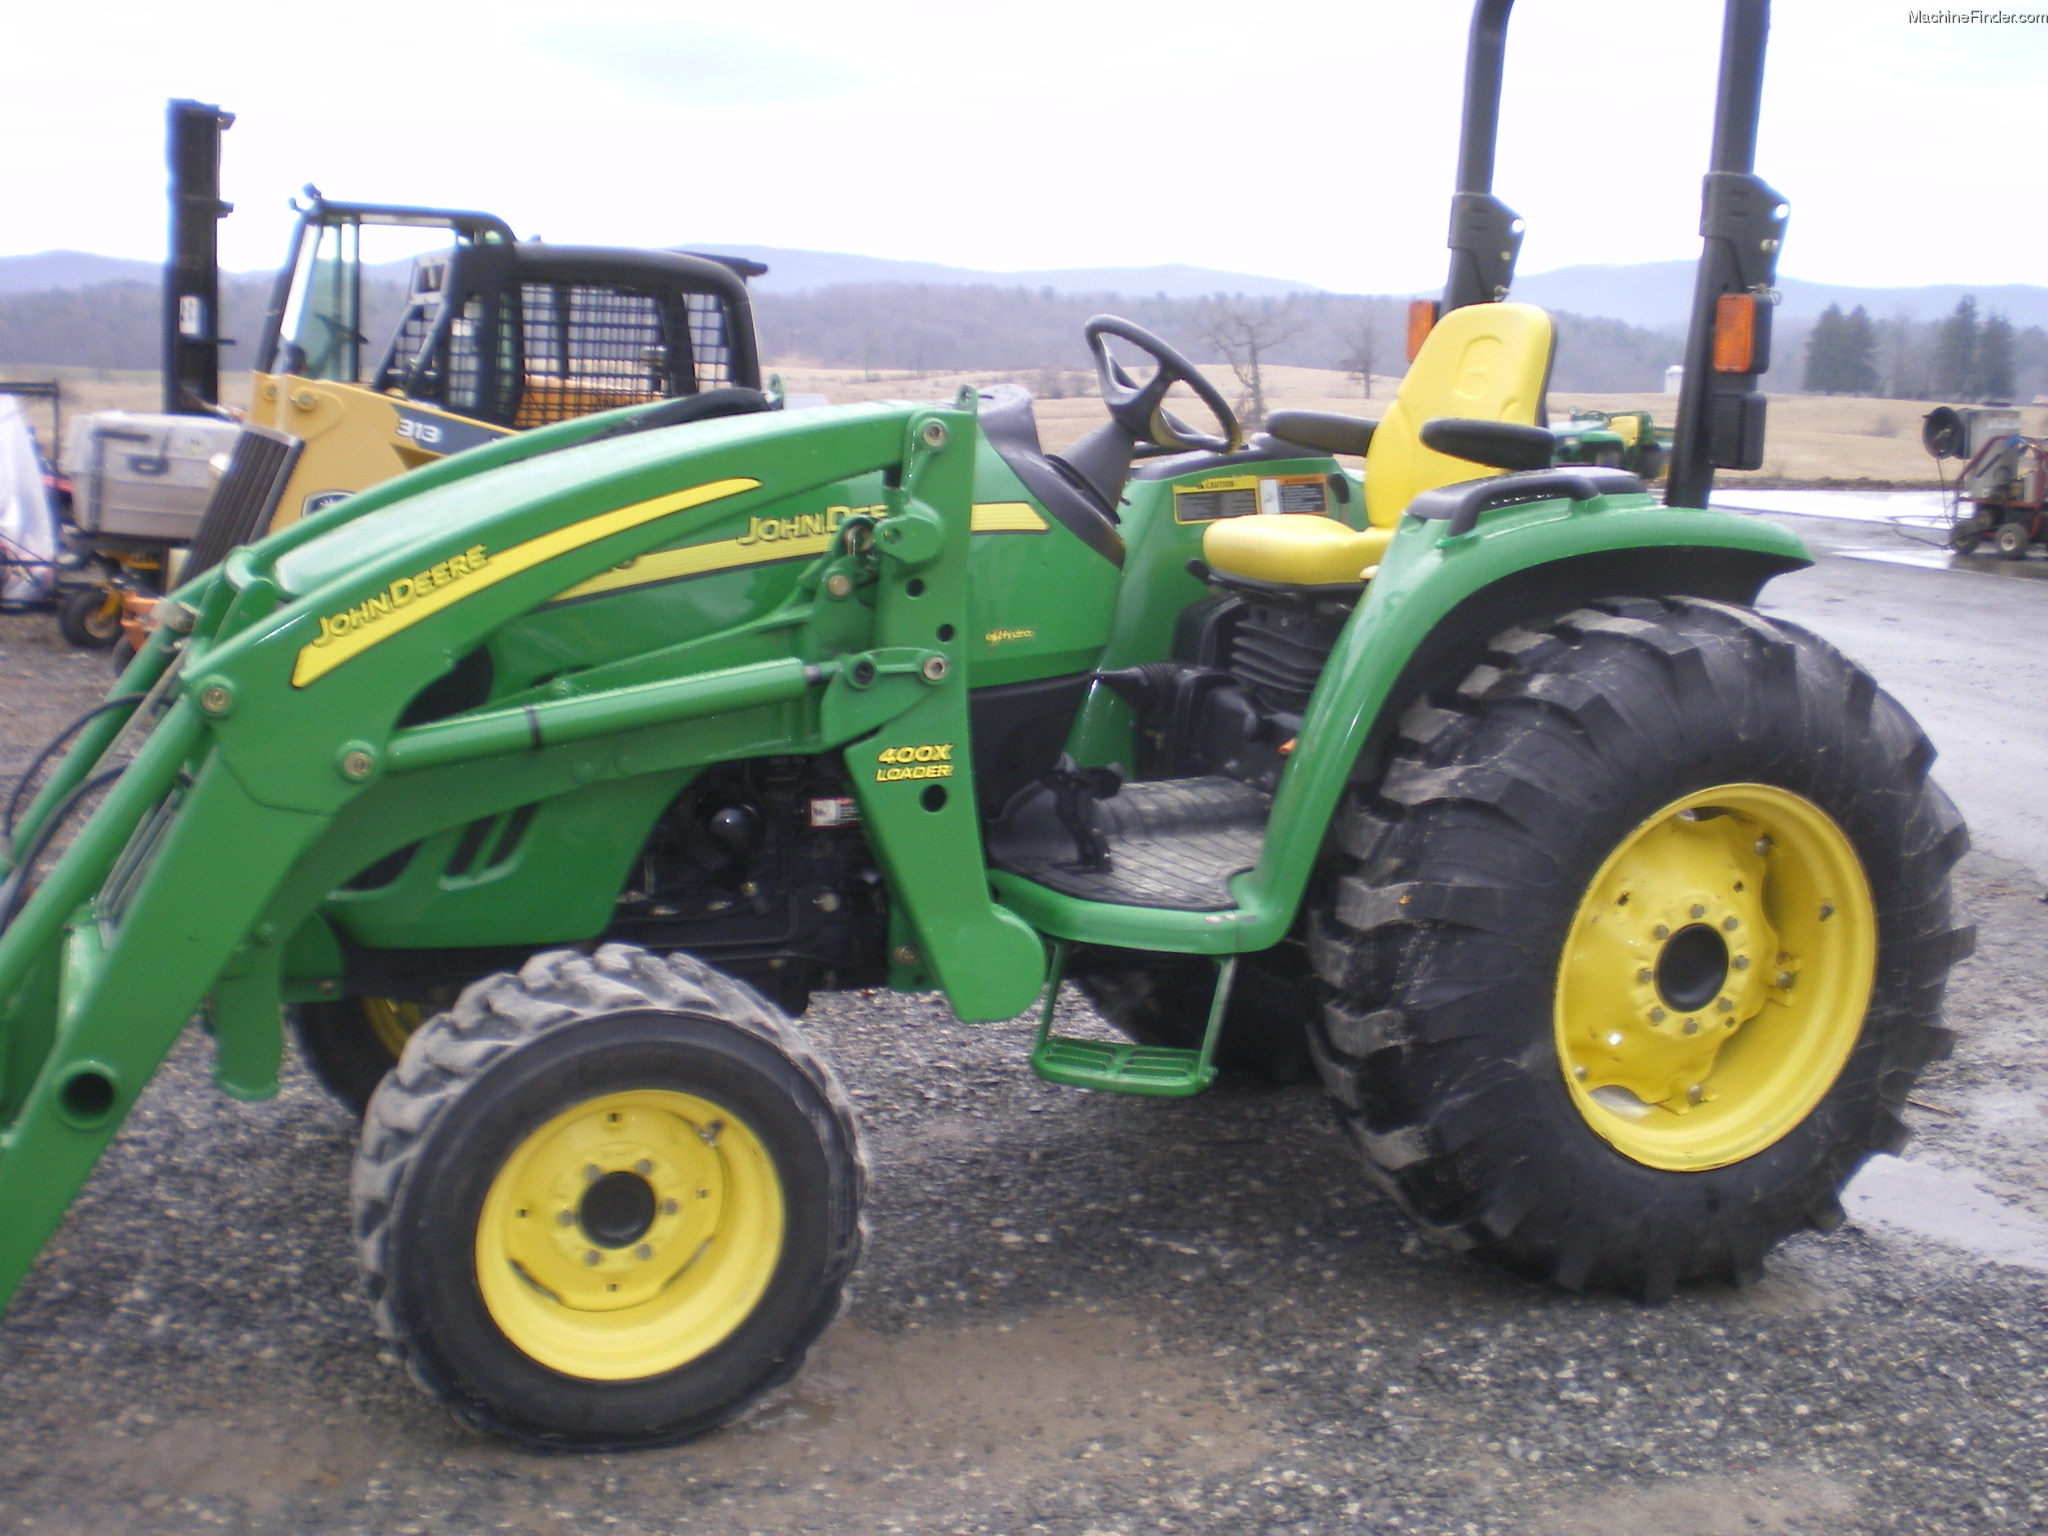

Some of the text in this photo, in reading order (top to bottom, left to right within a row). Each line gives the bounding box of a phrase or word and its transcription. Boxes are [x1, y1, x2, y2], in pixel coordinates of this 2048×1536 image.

[397, 419, 441, 443] 313
[736, 513, 825, 545] JOHN
[312, 544, 488, 648] JOHN DEERE
[877, 744, 953, 765] 400X
[876, 765, 954, 782] LOADER
